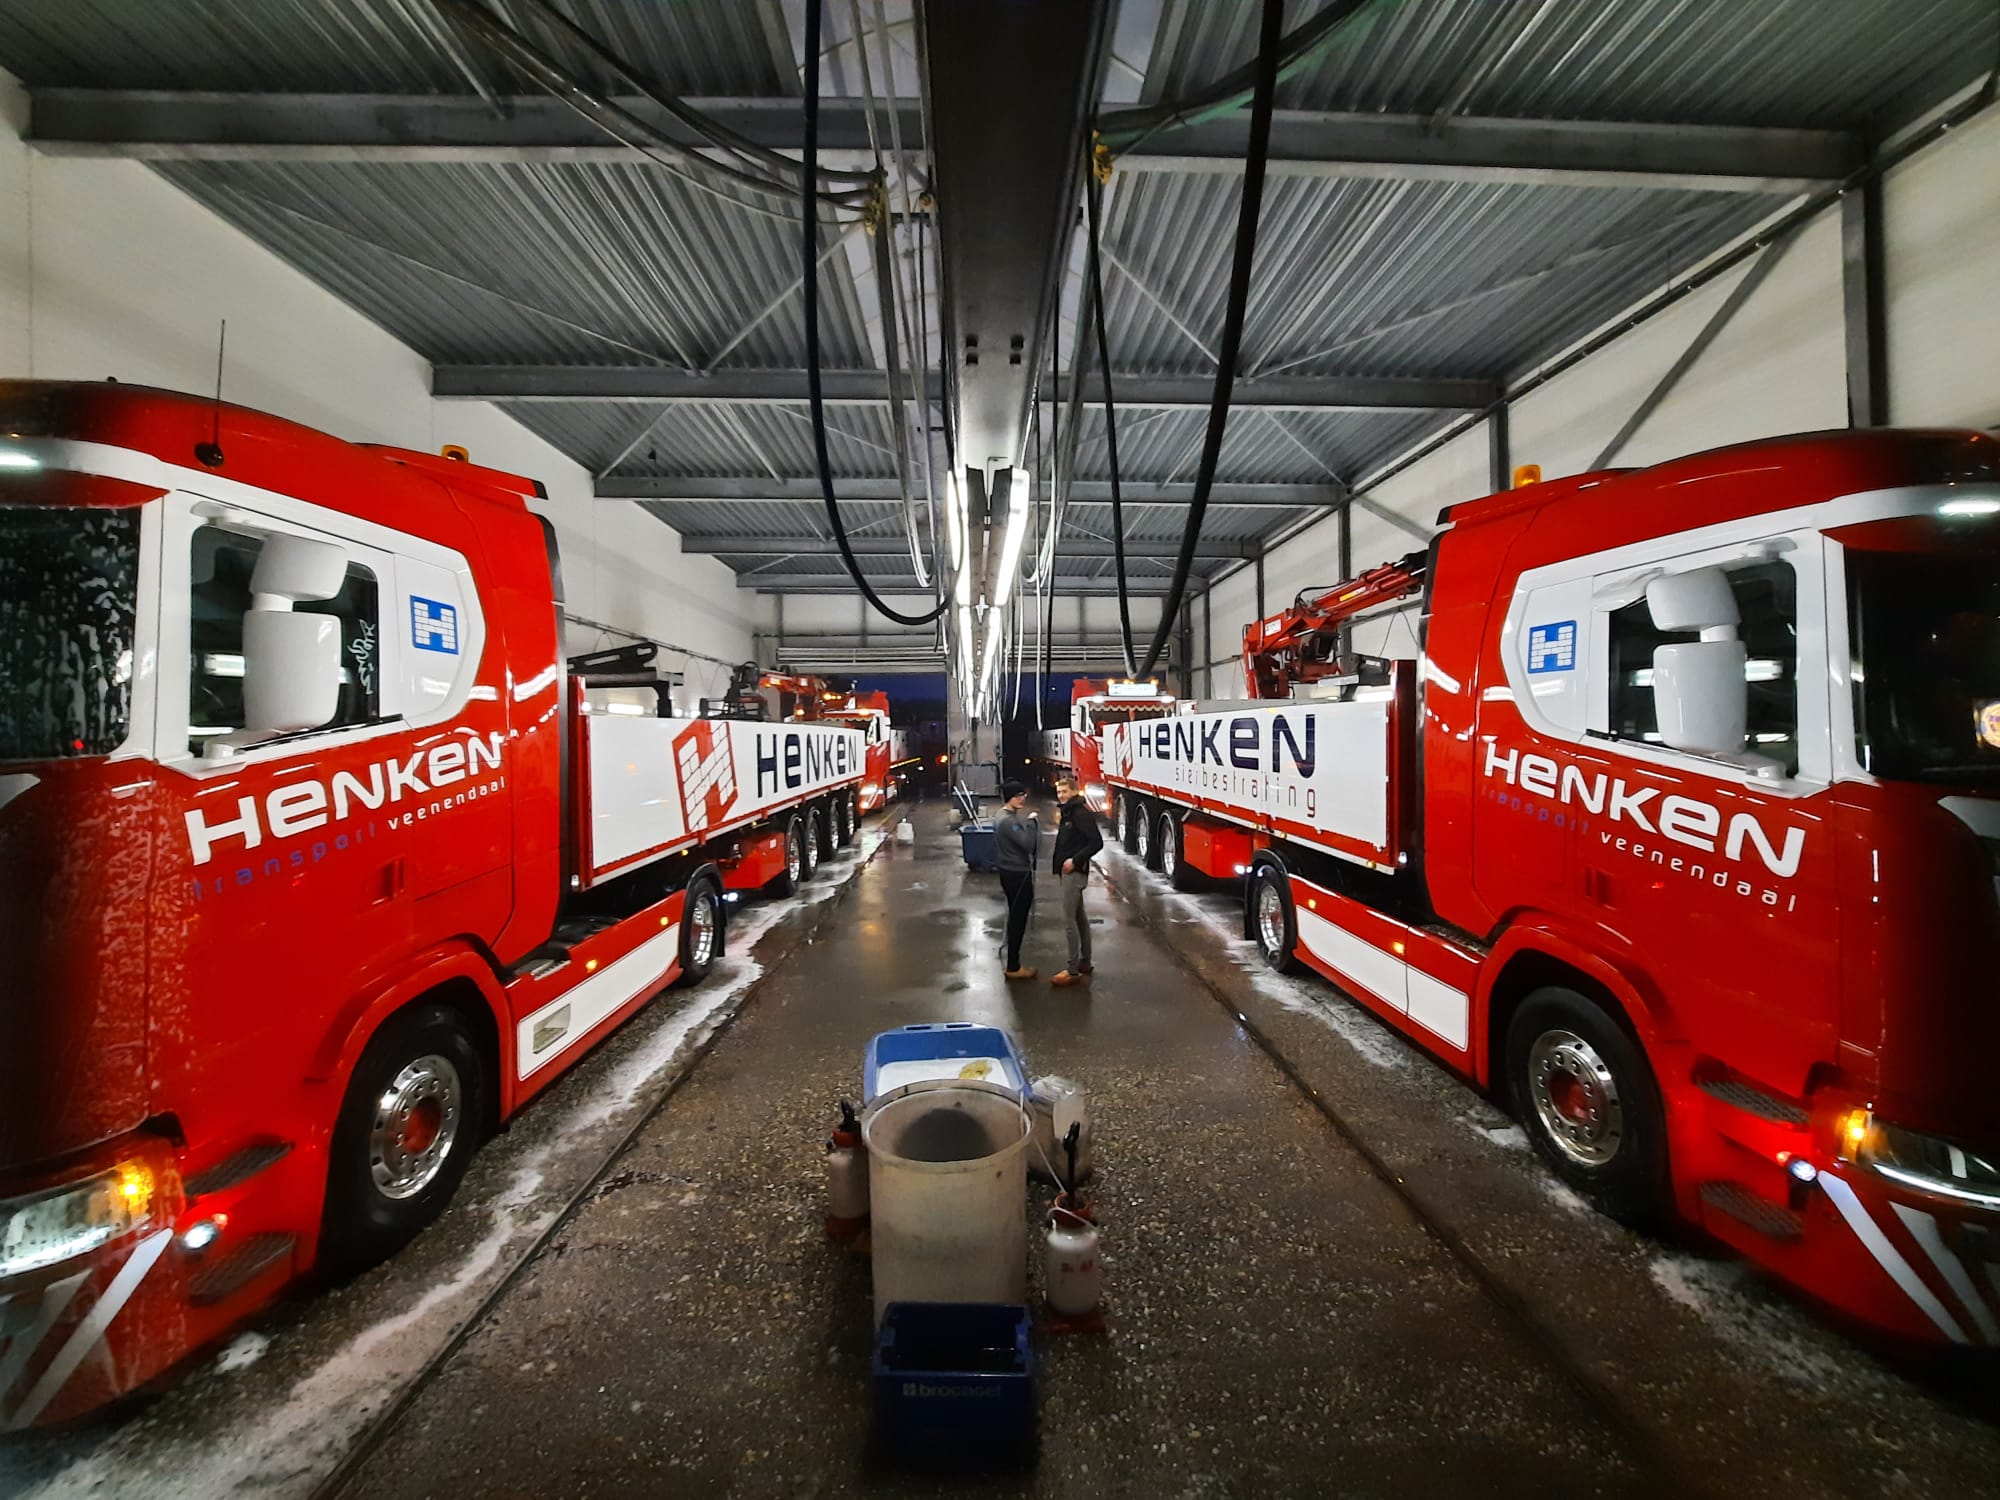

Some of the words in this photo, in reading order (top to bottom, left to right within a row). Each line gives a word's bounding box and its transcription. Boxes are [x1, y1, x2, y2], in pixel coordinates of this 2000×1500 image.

[1175, 765, 1316, 818] sierbestrating
[194, 822, 375, 898] transport
[388, 776, 505, 830] veenendaal
[1601, 831, 1796, 912] veenendaal
